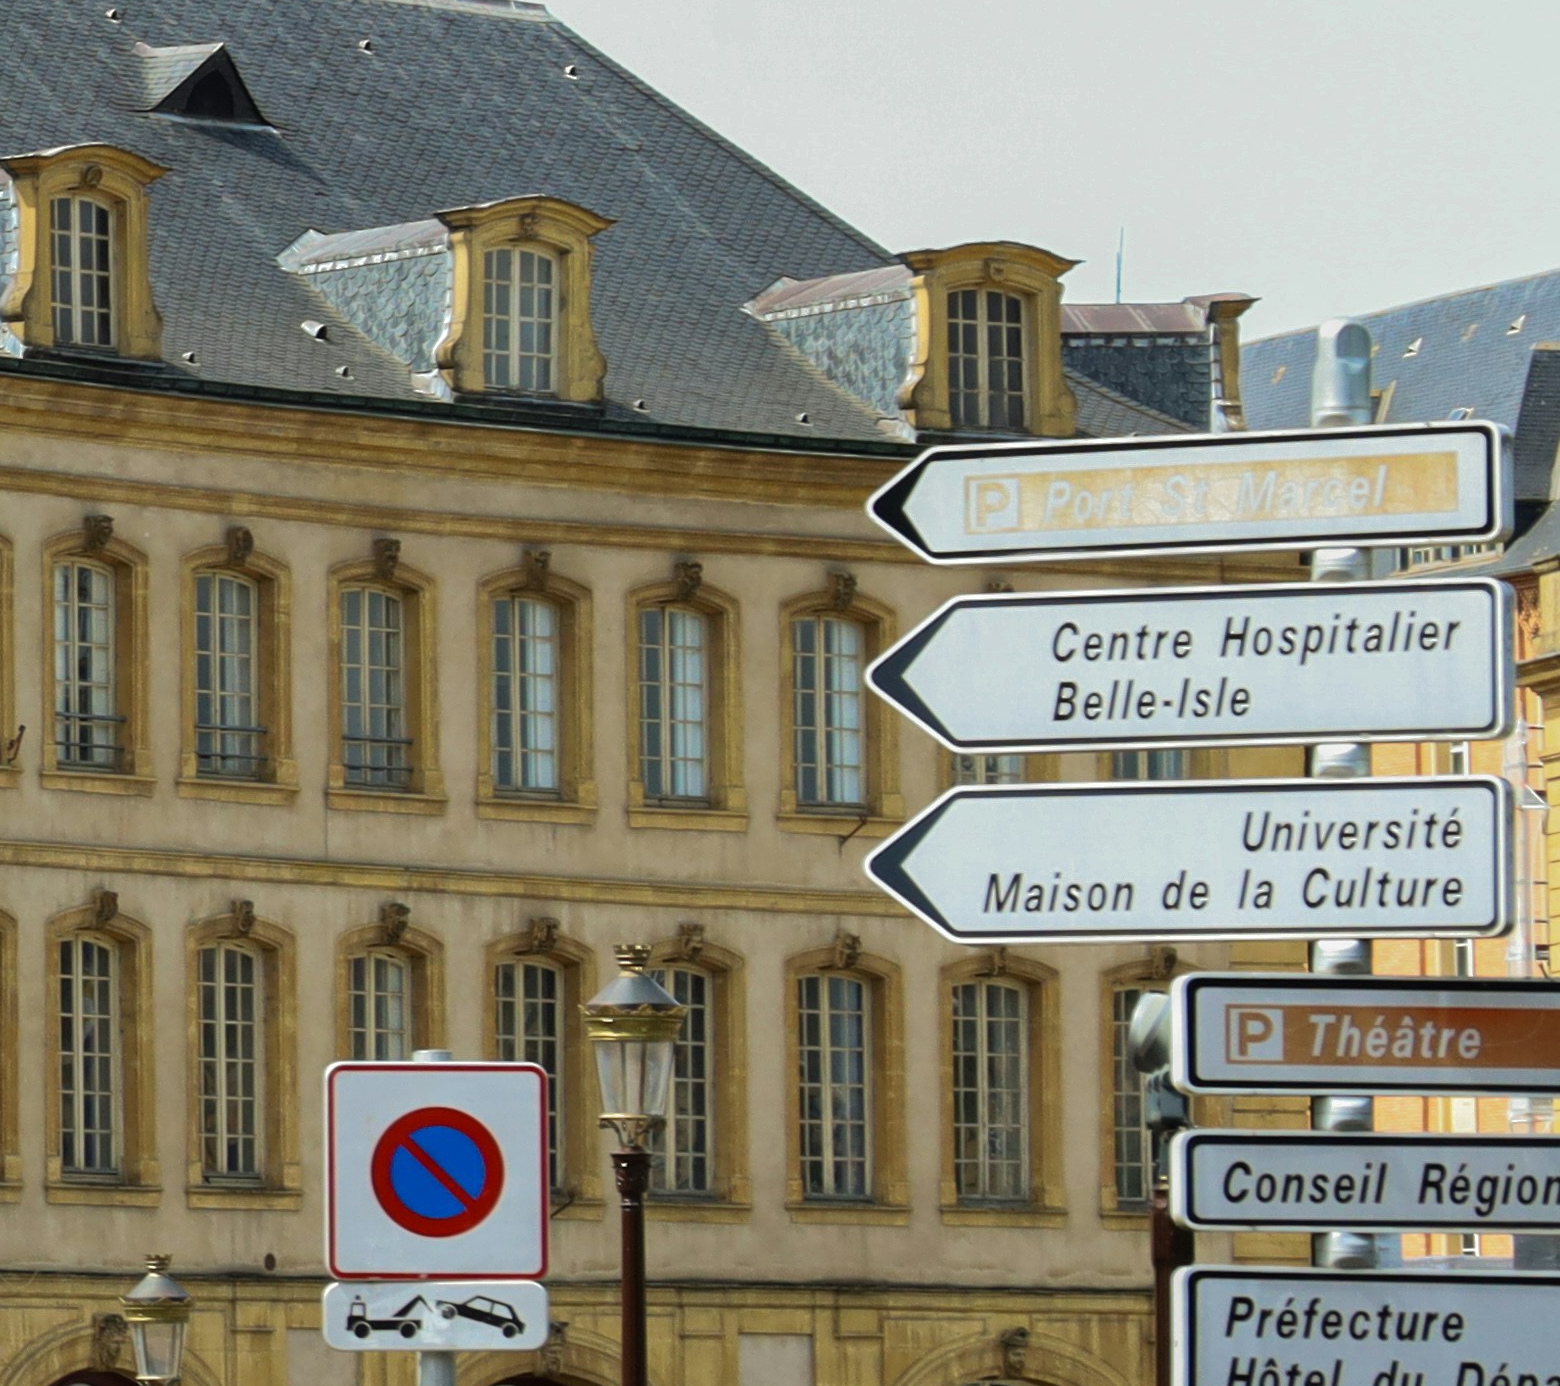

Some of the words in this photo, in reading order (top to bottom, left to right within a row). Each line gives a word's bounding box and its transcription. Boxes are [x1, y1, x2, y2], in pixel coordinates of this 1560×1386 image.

[977, 486, 1010, 527] P
[1041, 480, 1133, 525] Port
[1163, 474, 1209, 516] St
[1235, 465, 1388, 515] Marcel
[1052, 622, 1192, 663] Centre
[1220, 610, 1460, 666] Hospitalier
[1052, 677, 1250, 722] Belle-Isle
[1242, 807, 1462, 852] Université
[983, 872, 1134, 913] Maison
[1162, 870, 1209, 911] de
[1238, 869, 1273, 910] la
[1302, 867, 1462, 909] Culture
[1238, 1012, 1273, 1057] P
[1308, 1013, 1482, 1059] Théâtre
[1223, 1161, 1388, 1204] Conseil
[1418, 1162, 1560, 1217] Région
[1225, 1296, 1465, 1343] Préfecture
